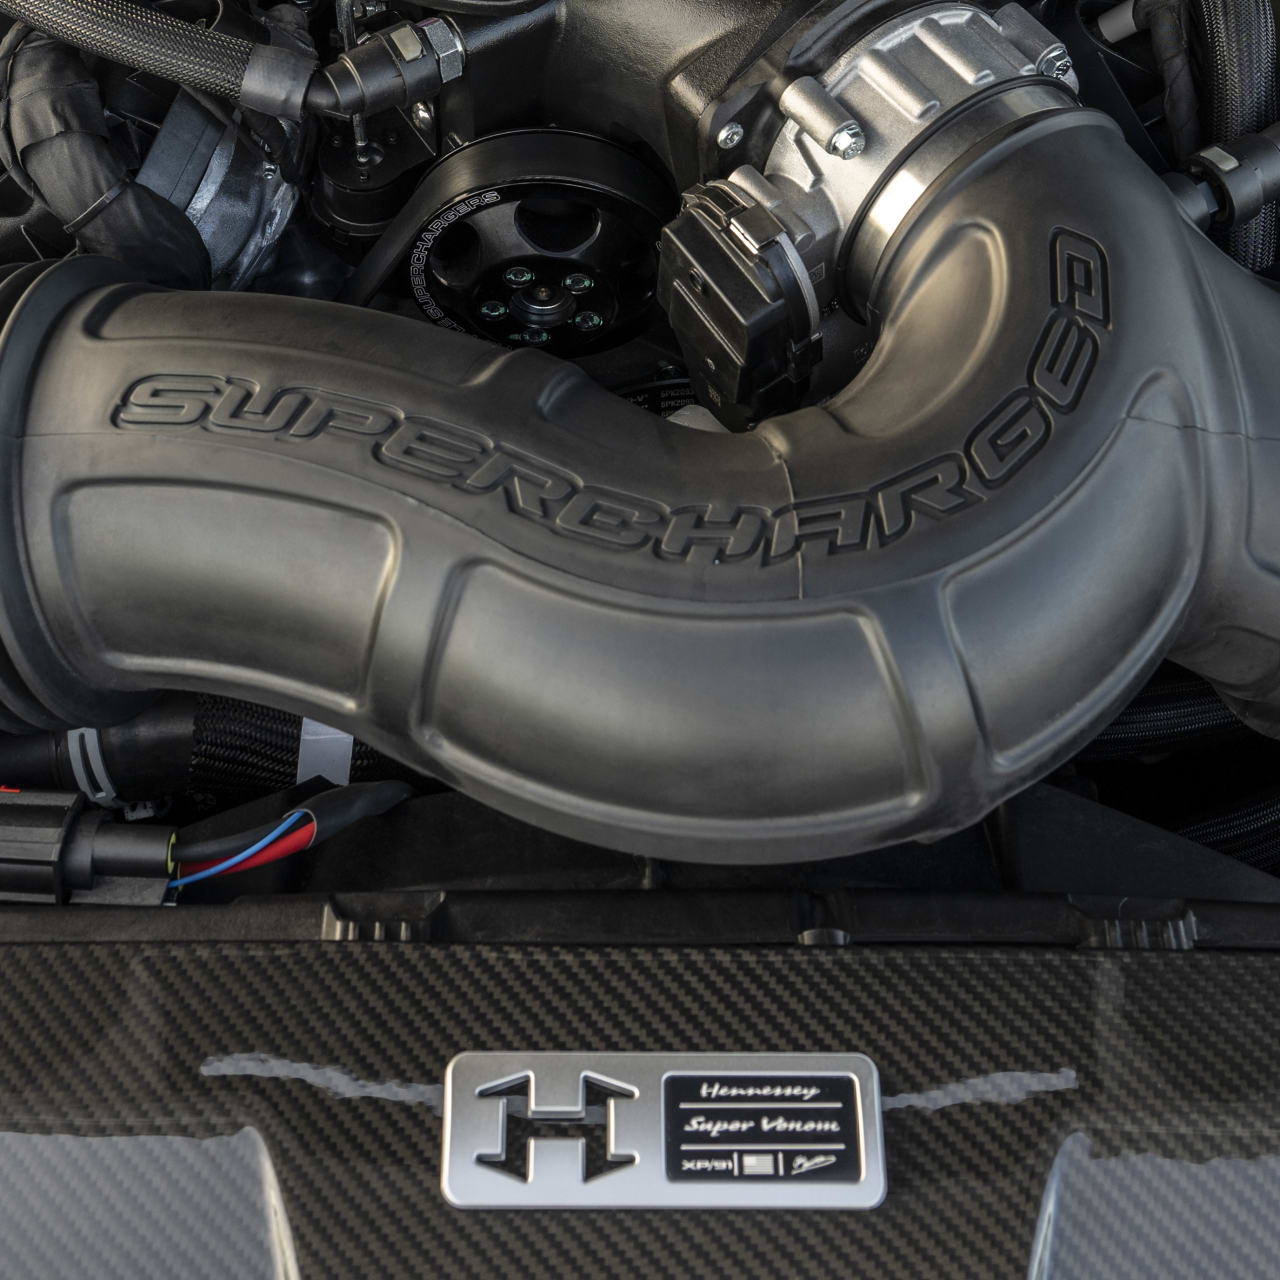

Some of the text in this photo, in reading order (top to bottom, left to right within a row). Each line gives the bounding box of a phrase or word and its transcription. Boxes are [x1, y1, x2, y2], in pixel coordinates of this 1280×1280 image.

[410, 190, 501, 319] SUPERCHARGERS
[111, 224, 1112, 568] SUPERCHARGED
[475, 1070, 640, 1185] H
[683, 1115, 841, 1138] Super Venom
[700, 1082, 821, 1101] Hennessey
